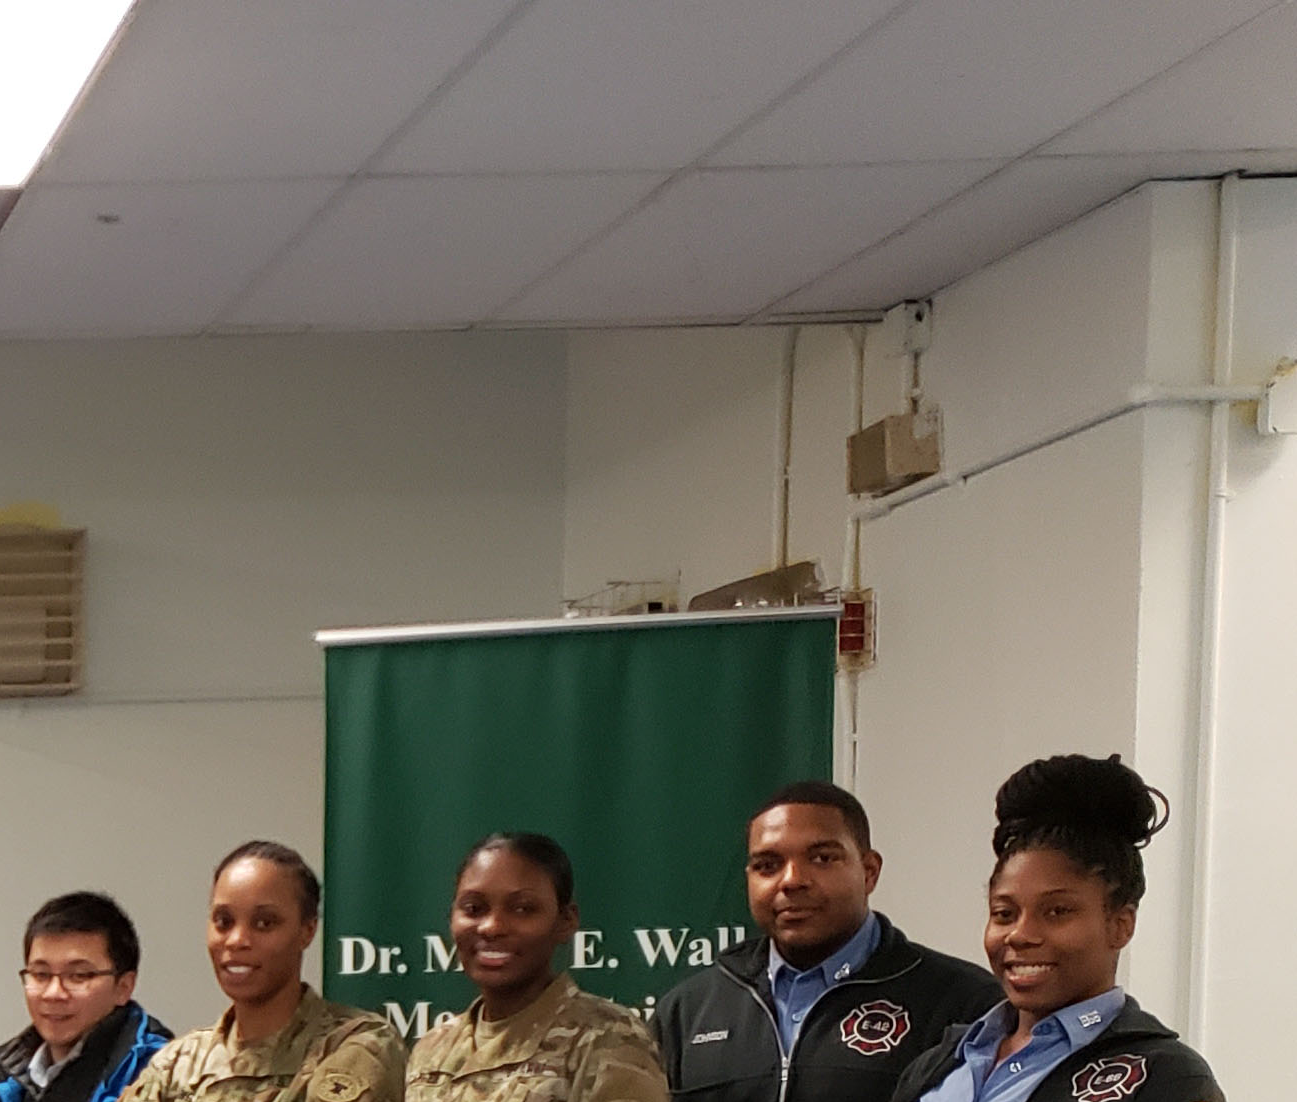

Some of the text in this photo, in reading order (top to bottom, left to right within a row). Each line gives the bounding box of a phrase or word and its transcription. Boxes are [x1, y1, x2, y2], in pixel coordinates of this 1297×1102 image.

[337, 935, 407, 974] Dr.
[572, 930, 619, 969] E.
[860, 1020, 891, 1033] E-42
